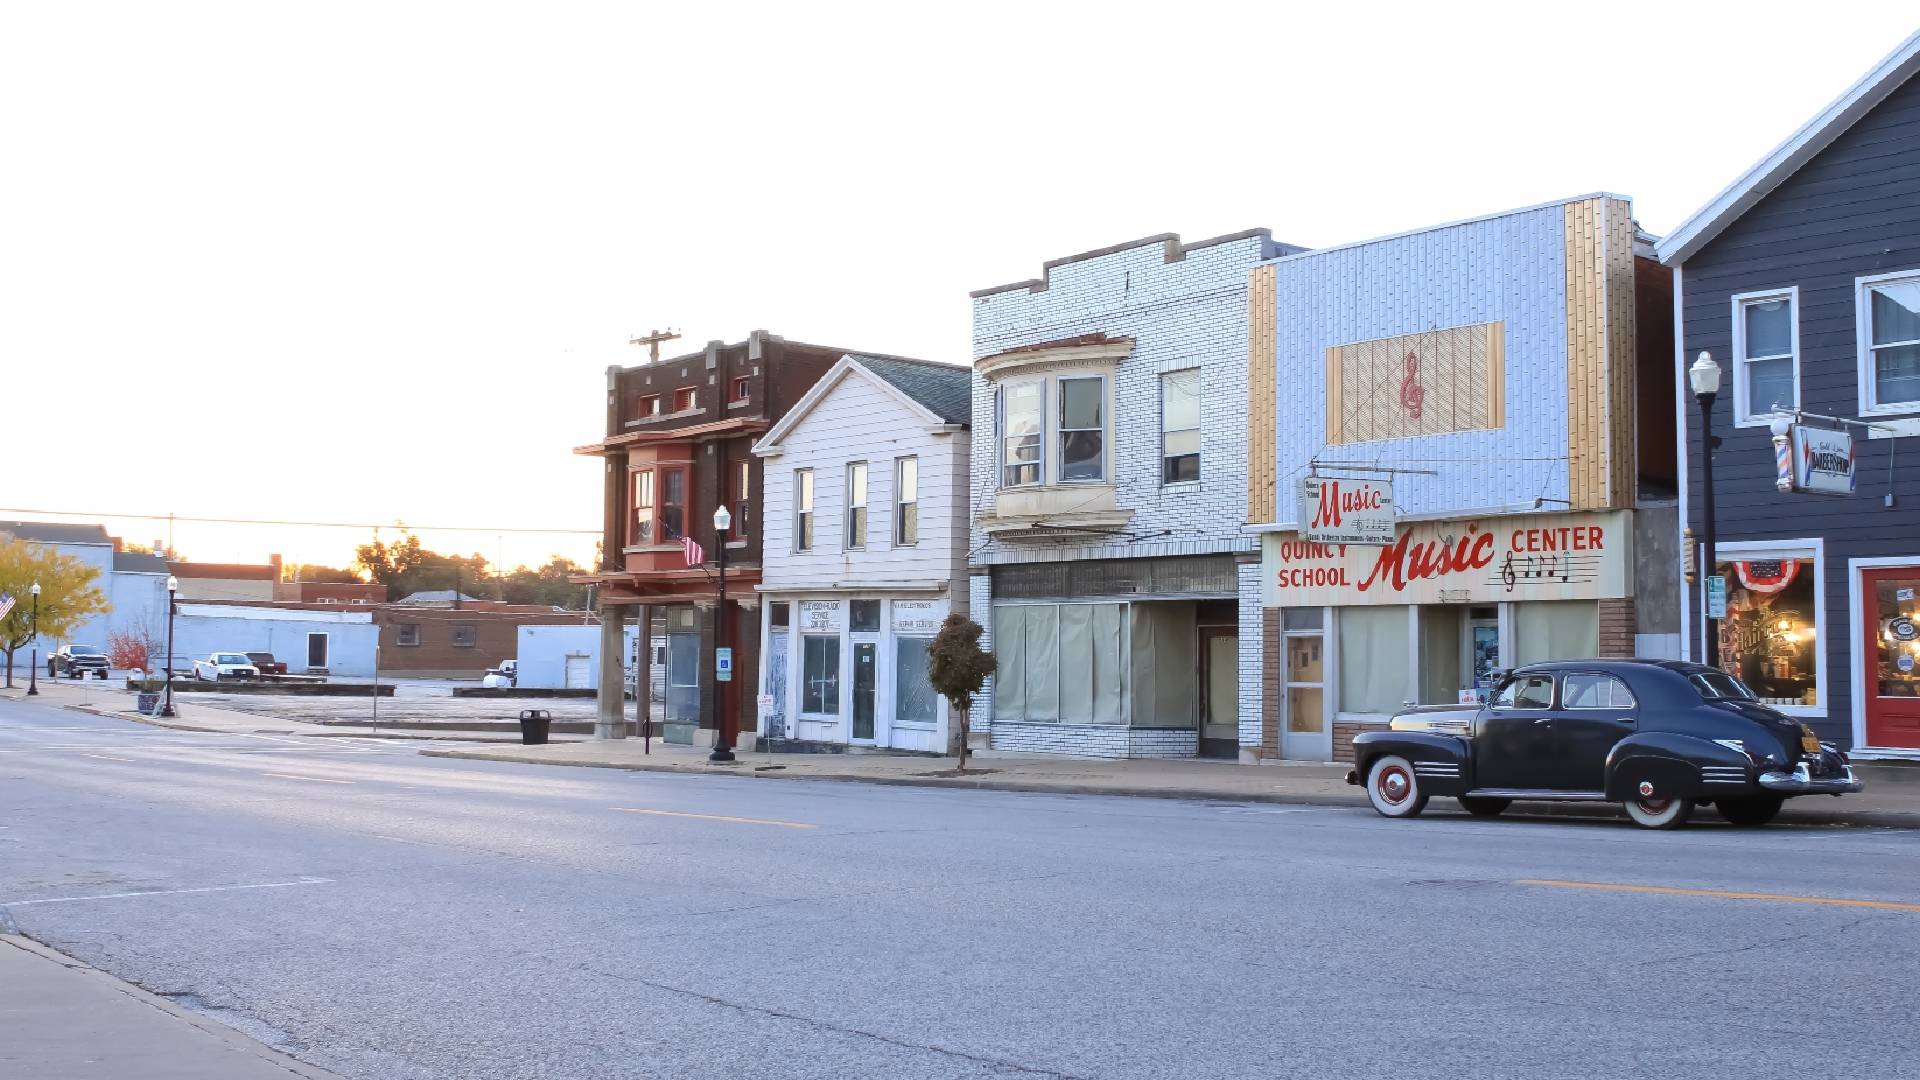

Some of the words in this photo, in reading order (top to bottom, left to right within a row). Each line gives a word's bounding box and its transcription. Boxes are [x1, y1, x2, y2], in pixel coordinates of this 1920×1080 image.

[1811, 451, 1849, 473] BARBERSHOP
[1312, 481, 1381, 529] Music
[1512, 527, 1604, 552] CENTER
[1281, 541, 1347, 563] QUINCY
[1358, 523, 1495, 591] Music
[1278, 568, 1351, 587] SCHOOL
